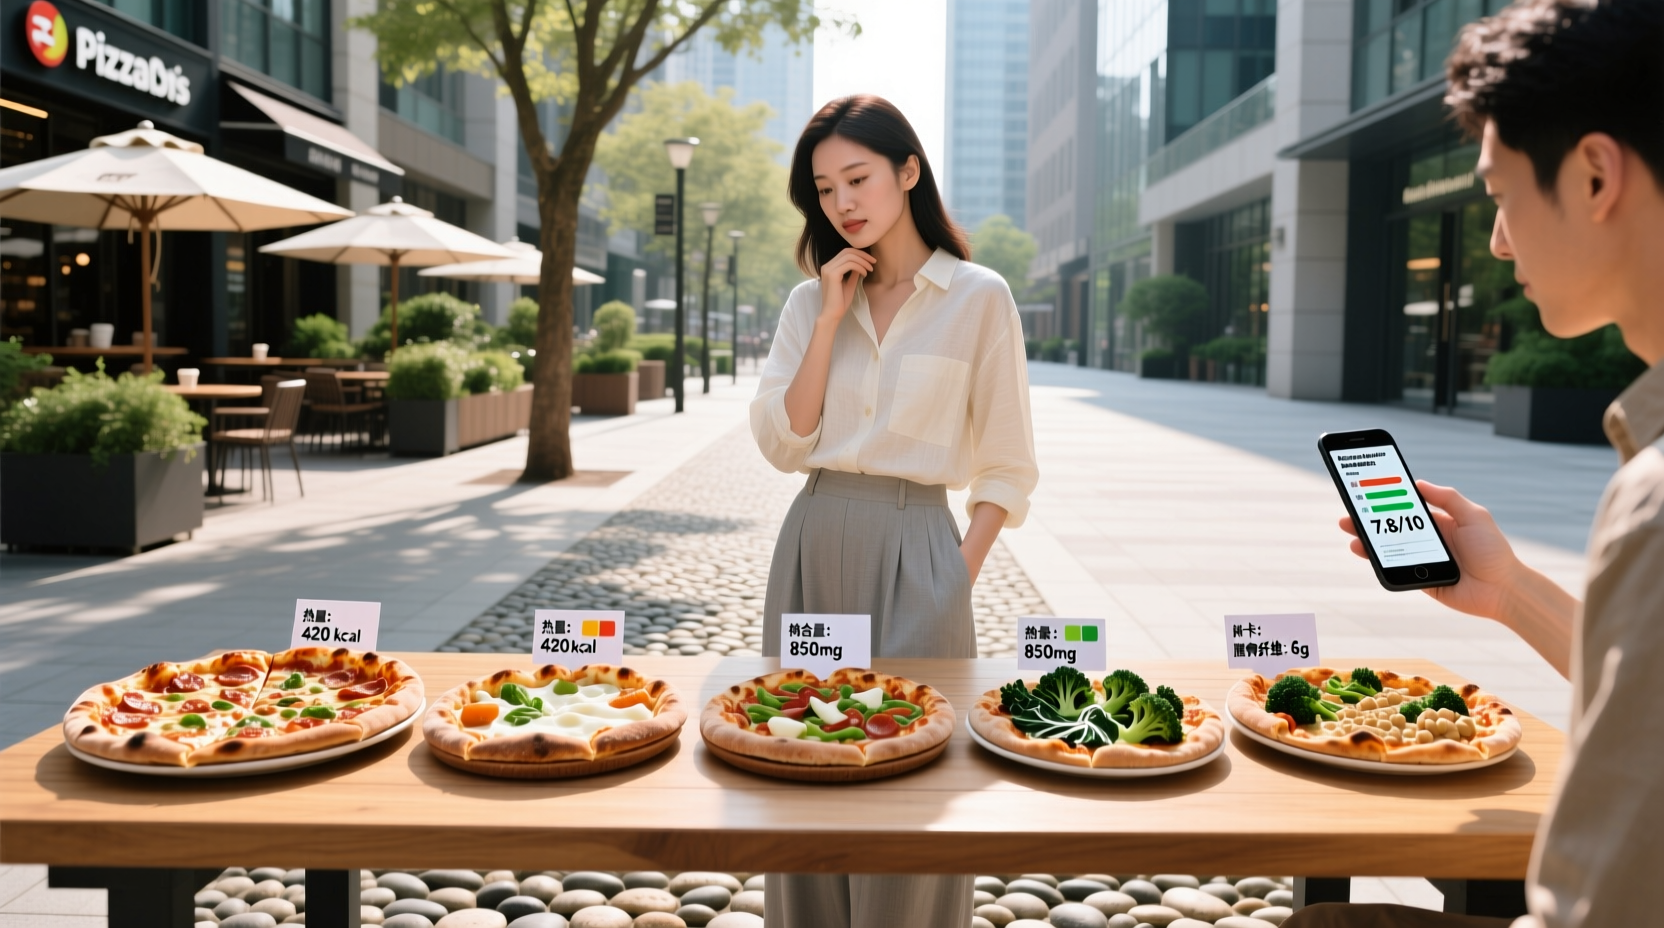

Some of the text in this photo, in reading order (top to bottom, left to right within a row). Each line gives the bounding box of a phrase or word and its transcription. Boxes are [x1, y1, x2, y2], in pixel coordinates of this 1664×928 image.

[301, 626, 361, 643] 420 kcal
[790, 641, 842, 661] 850mg
[1024, 644, 1076, 664] 850mg
[1291, 640, 1309, 659] 6g
